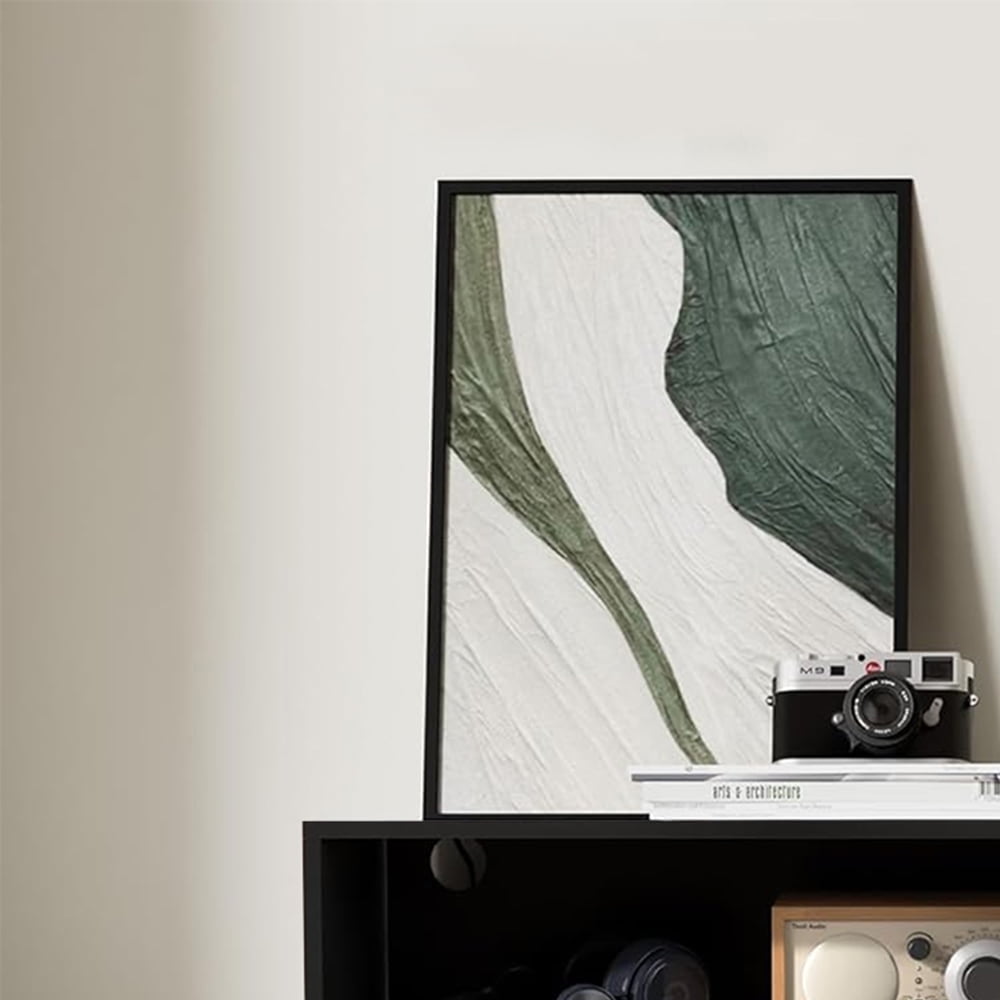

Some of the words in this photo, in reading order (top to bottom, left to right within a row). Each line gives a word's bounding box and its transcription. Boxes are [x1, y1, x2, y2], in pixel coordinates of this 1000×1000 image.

[800, 667, 825, 675] M9
[712, 785, 731, 799] arts
[746, 785, 801, 799] architecture
